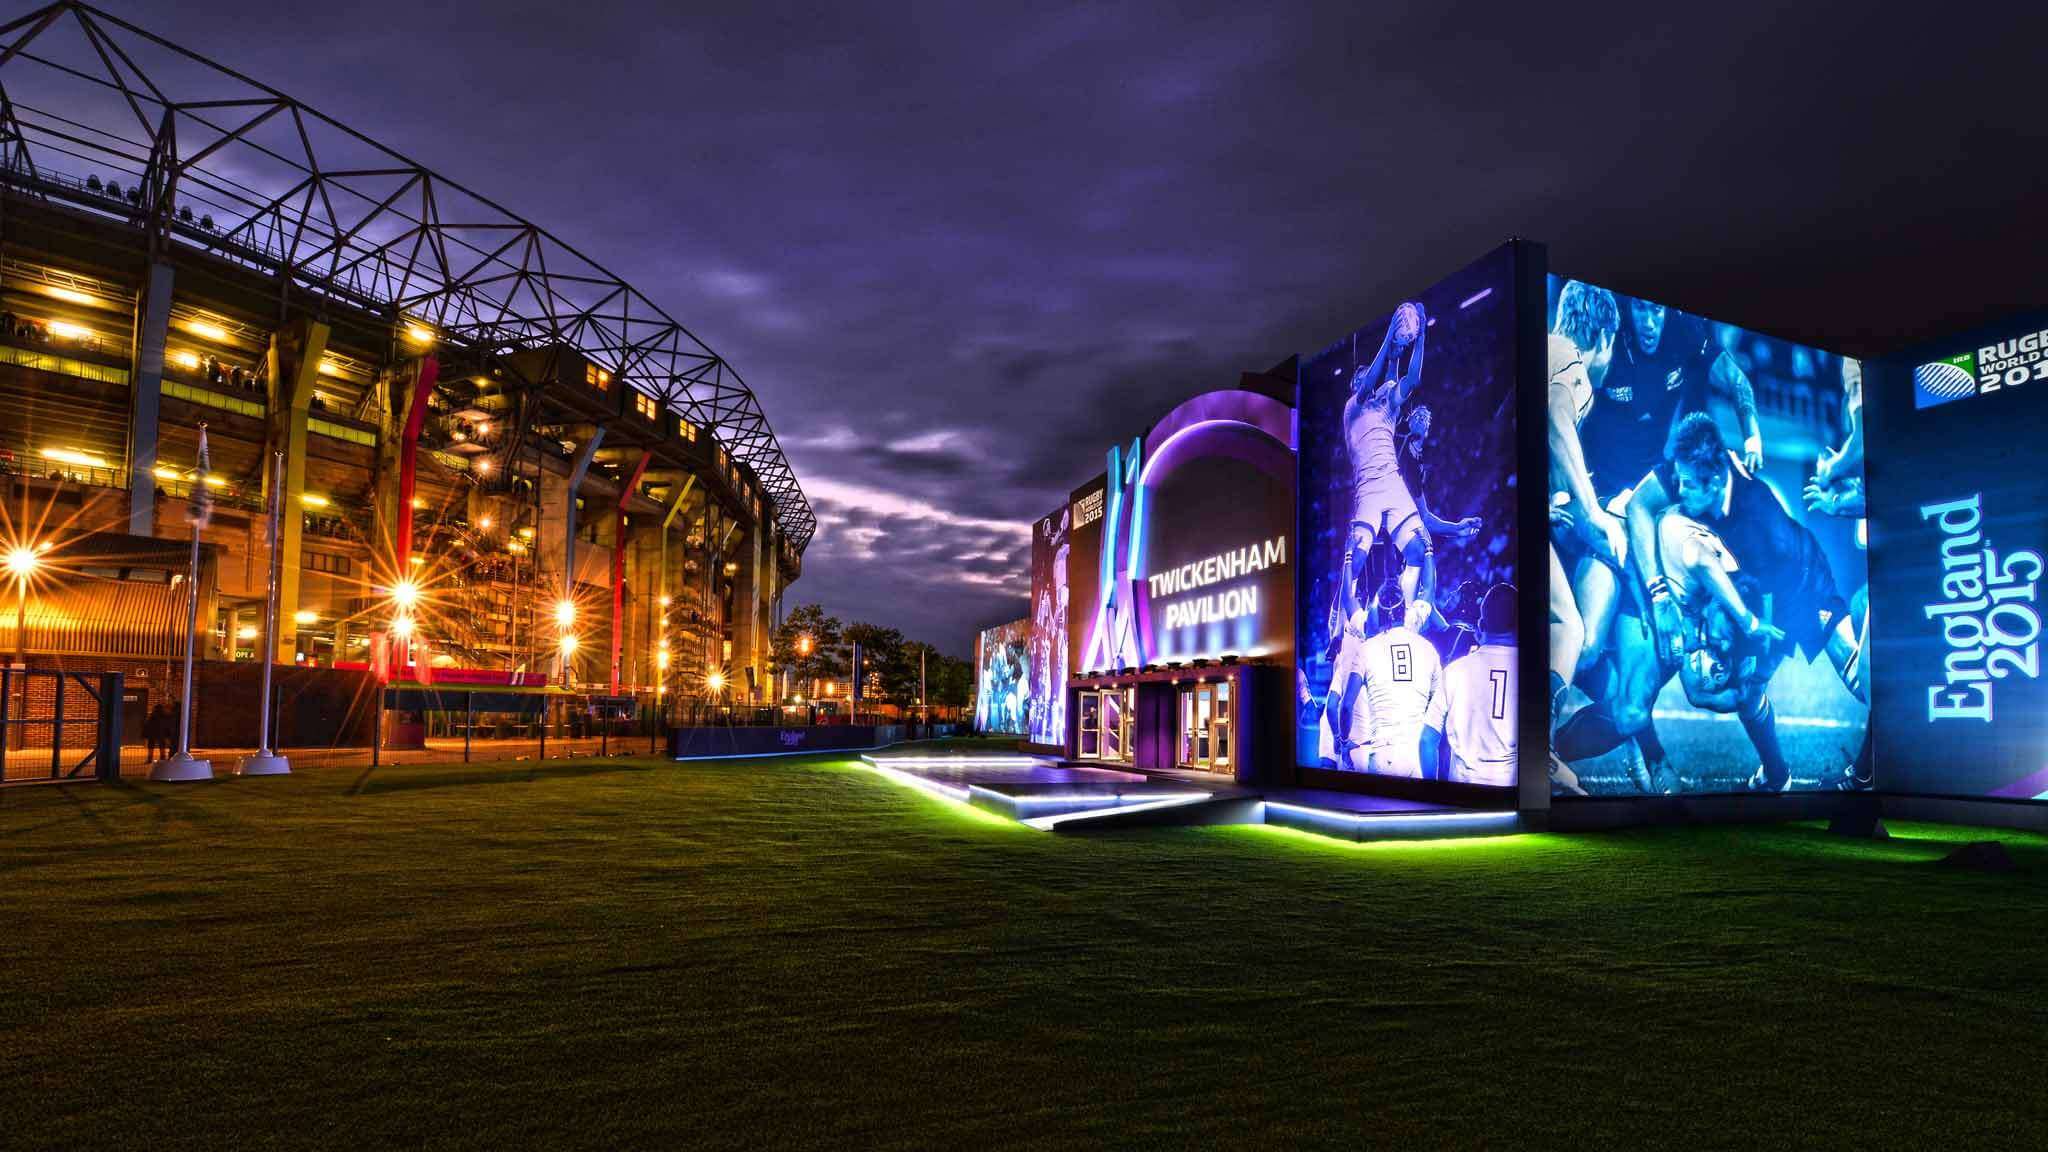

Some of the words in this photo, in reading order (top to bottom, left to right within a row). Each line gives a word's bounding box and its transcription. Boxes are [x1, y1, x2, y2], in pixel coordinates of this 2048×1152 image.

[1979, 351, 2041, 375] WORLD
[1084, 506, 1103, 524] 2015
[1148, 535, 1286, 599] TWICKENHAM
[1165, 585, 1257, 631] PAVILION
[1920, 492, 1997, 722] England
[1984, 549, 2044, 679] 2015
[1390, 643, 1413, 682] 8
[1489, 669, 1508, 720] 1
